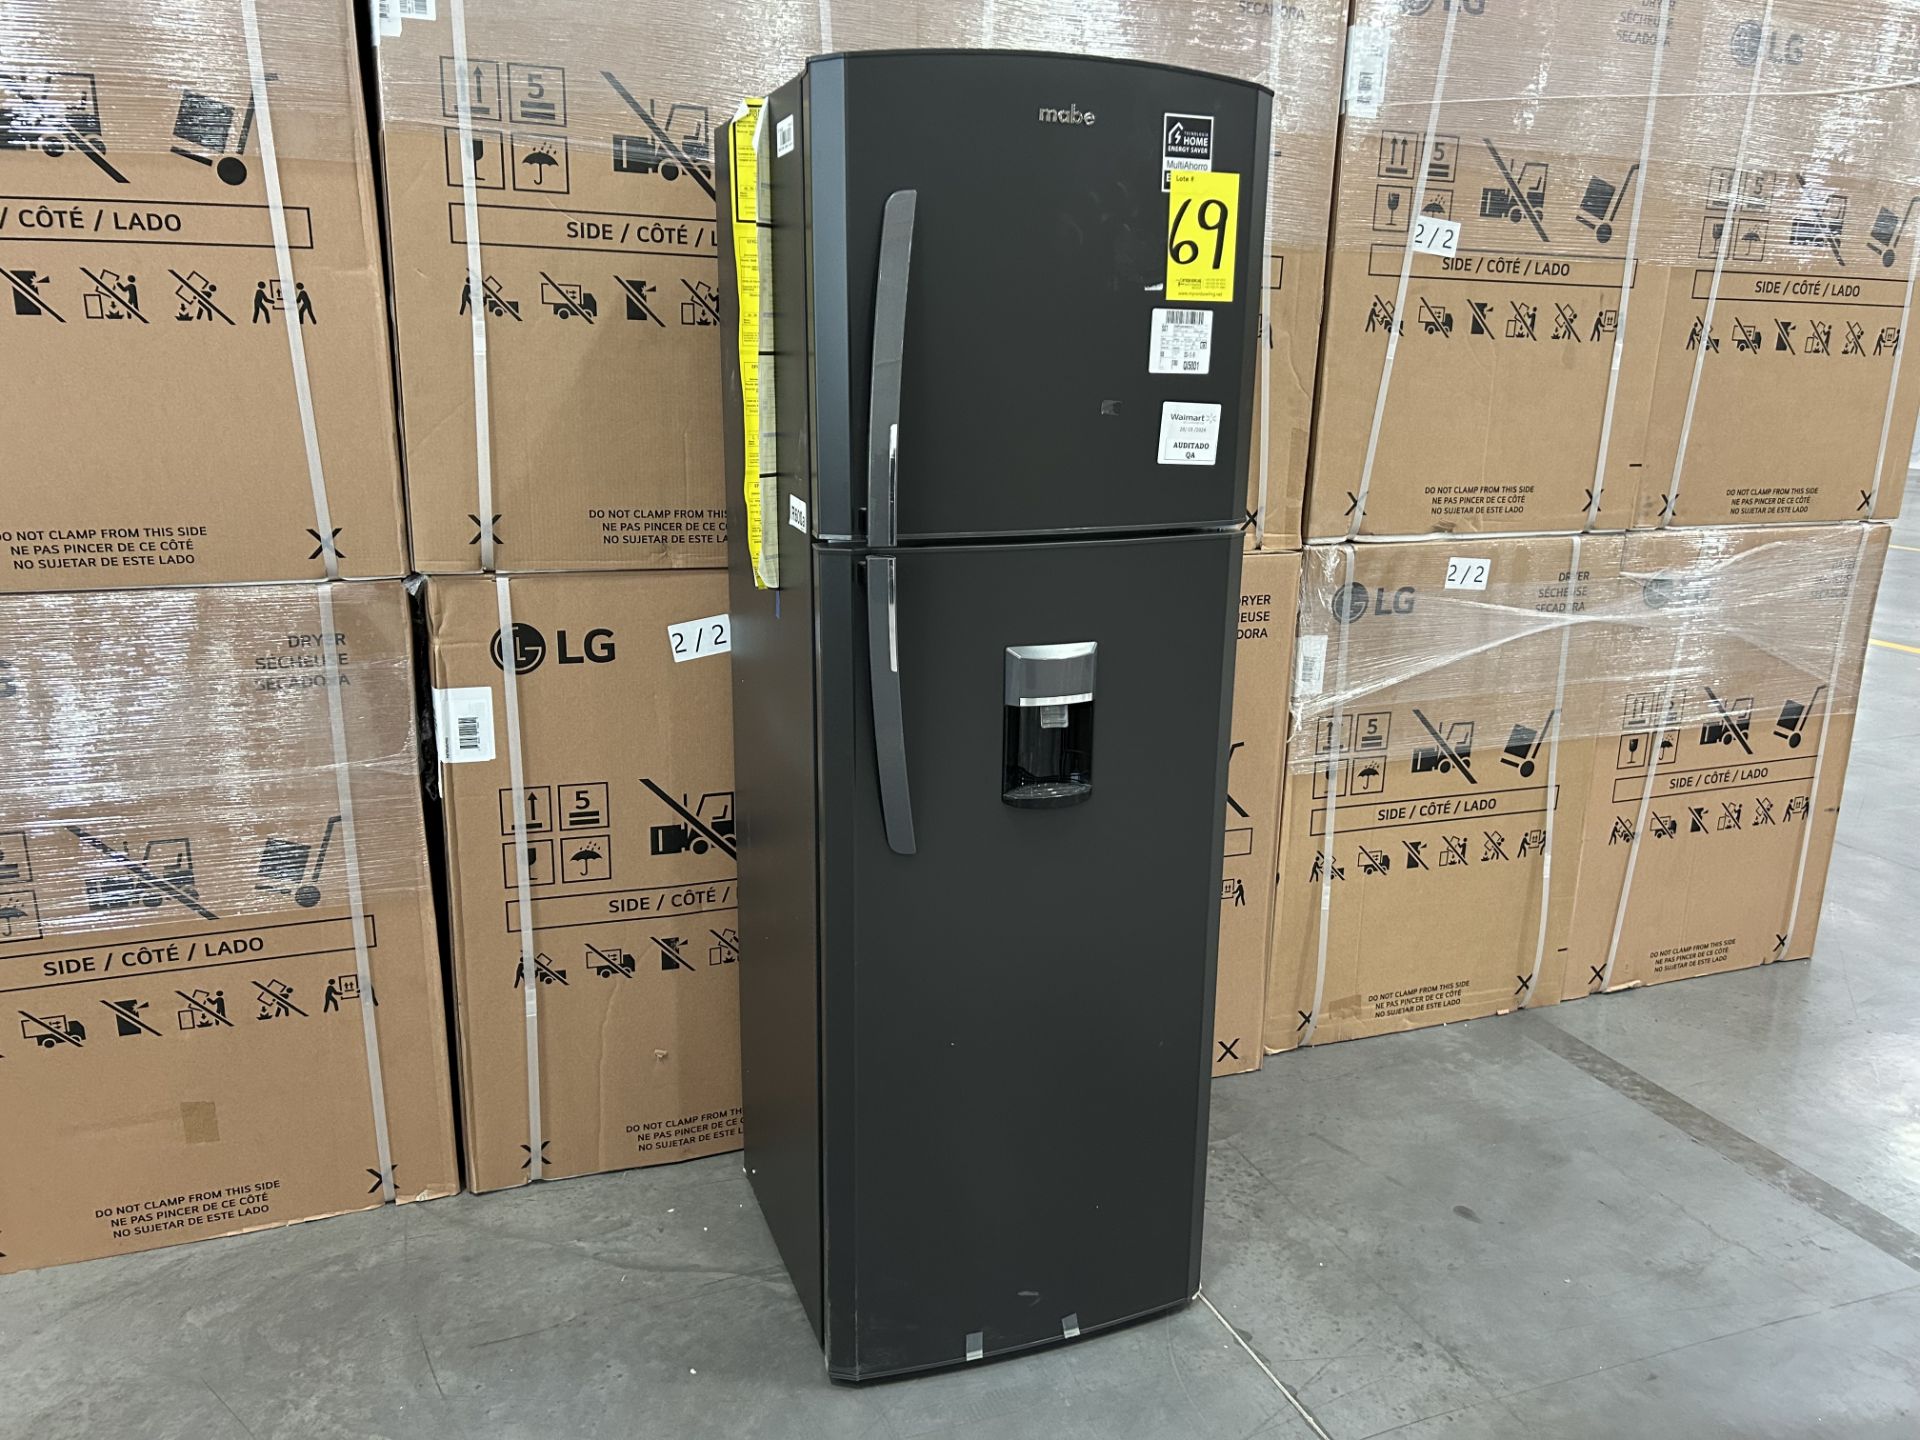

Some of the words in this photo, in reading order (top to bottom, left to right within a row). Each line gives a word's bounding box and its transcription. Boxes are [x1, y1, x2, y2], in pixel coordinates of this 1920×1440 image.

[1038, 103, 1096, 125] mabe
[1183, 136, 1209, 146] HOME
[1167, 160, 1208, 171] MultiAhorro
[19, 205, 84, 228] CÔTÉ
[94, 210, 103, 231] /
[114, 212, 181, 231] LADO
[567, 222, 613, 240] SIDE
[621, 223, 629, 243] /
[637, 223, 688, 244] CÔTÉ
[695, 228, 704, 247] /
[1169, 198, 1228, 269] 69
[1442, 257, 1472, 272] SIDE
[1476, 257, 1483, 273] /
[1487, 257, 1520, 273] CÔTÉ
[1524, 260, 1532, 276] /
[1535, 262, 1569, 276] LADO
[1755, 281, 1781, 293] SIDE
[1783, 281, 1791, 295] /
[1792, 280, 1821, 295] CÔTÉ
[1822, 283, 1830, 297] /
[1832, 285, 1860, 297] LADO
[1170, 413, 1205, 421] Walmart
[1508, 495, 1525, 503] CÔTÉ
[589, 510, 604, 518] DO
[609, 510, 630, 518] NOT
[634, 510, 671, 518] CLAMP
[674, 510, 704, 518] FROM
[0, 531, 12, 542] O
[17, 531, 44, 541] NOT
[49, 530, 96, 540] CLAMP
[101, 529, 139, 538] FROM
[143, 528, 173, 537] THIS
[178, 527, 207, 536] SIDE
[603, 523, 616, 531] NE
[621, 523, 640, 531] PAS
[644, 523, 682, 531] PINCER
[703, 523, 715, 531] CE
[11, 546, 29, 555] NE
[33, 545, 59, 554] PAS
[64, 543, 113, 553] PINCER
[118, 543, 134, 552] DE
[140, 542, 156, 551] CE
[160, 539, 193, 550] CÔTÉ
[623, 535, 668, 543] SUJETAR
[671, 535, 685, 543] DE
[689, 535, 713, 543] ESTE
[14, 560, 34, 569] NO
[38, 558, 96, 568] SUJETAR
[101, 557, 118, 566] DE
[123, 556, 155, 565] ESTE
[159, 555, 194, 564] LADO
[1374, 587, 1416, 616] LG
[557, 629, 615, 664] LG
[1670, 777, 1693, 789] SIDE
[1695, 774, 1702, 787] /
[1704, 771, 1730, 784] CÔTÉ
[1732, 770, 1738, 782] /
[1741, 768, 1768, 780] LADO
[1378, 808, 1406, 820] SIDE
[1409, 805, 1416, 819] /
[1420, 800, 1451, 816] CÔTÉ
[1454, 801, 1461, 814] /
[1464, 799, 1496, 811] LADO
[609, 897, 650, 913] SIDE
[657, 894, 664, 911] /
[672, 887, 716, 907] CÔTÉ
[722, 887, 730, 903] /
[44, 957, 95, 976] SIDE
[104, 953, 112, 971] /
[122, 947, 179, 966] CÔTÉ
[188, 943, 196, 961] /
[205, 938, 263, 956] LADO
[1395, 988, 1417, 997] CLAMP
[1419, 985, 1437, 993] FROM
[1401, 996, 1423, 1005] PINCER
[1445, 989, 1461, 998] CÔTÉ
[96, 1209, 112, 1218] DO
[117, 1204, 140, 1214] NOT
[144, 1197, 185, 1210] CLAMP
[189, 1190, 222, 1202] FROM
[225, 1185, 251, 1196] THIS
[255, 1180, 280, 1191] SIDE
[111, 1218, 127, 1227] NE
[131, 1213, 153, 1224] PAS
[157, 1206, 199, 1219] PINCER
[203, 1203, 217, 1211] DE
[222, 1199, 235, 1208] CE
[240, 1192, 268, 1205] CÔTÉ
[113, 1229, 130, 1238] NO
[134, 1219, 185, 1234] SUJETAR
[188, 1216, 203, 1225] DE
[207, 1211, 234, 1222] ESTE
[238, 1205, 269, 1217] LADO
